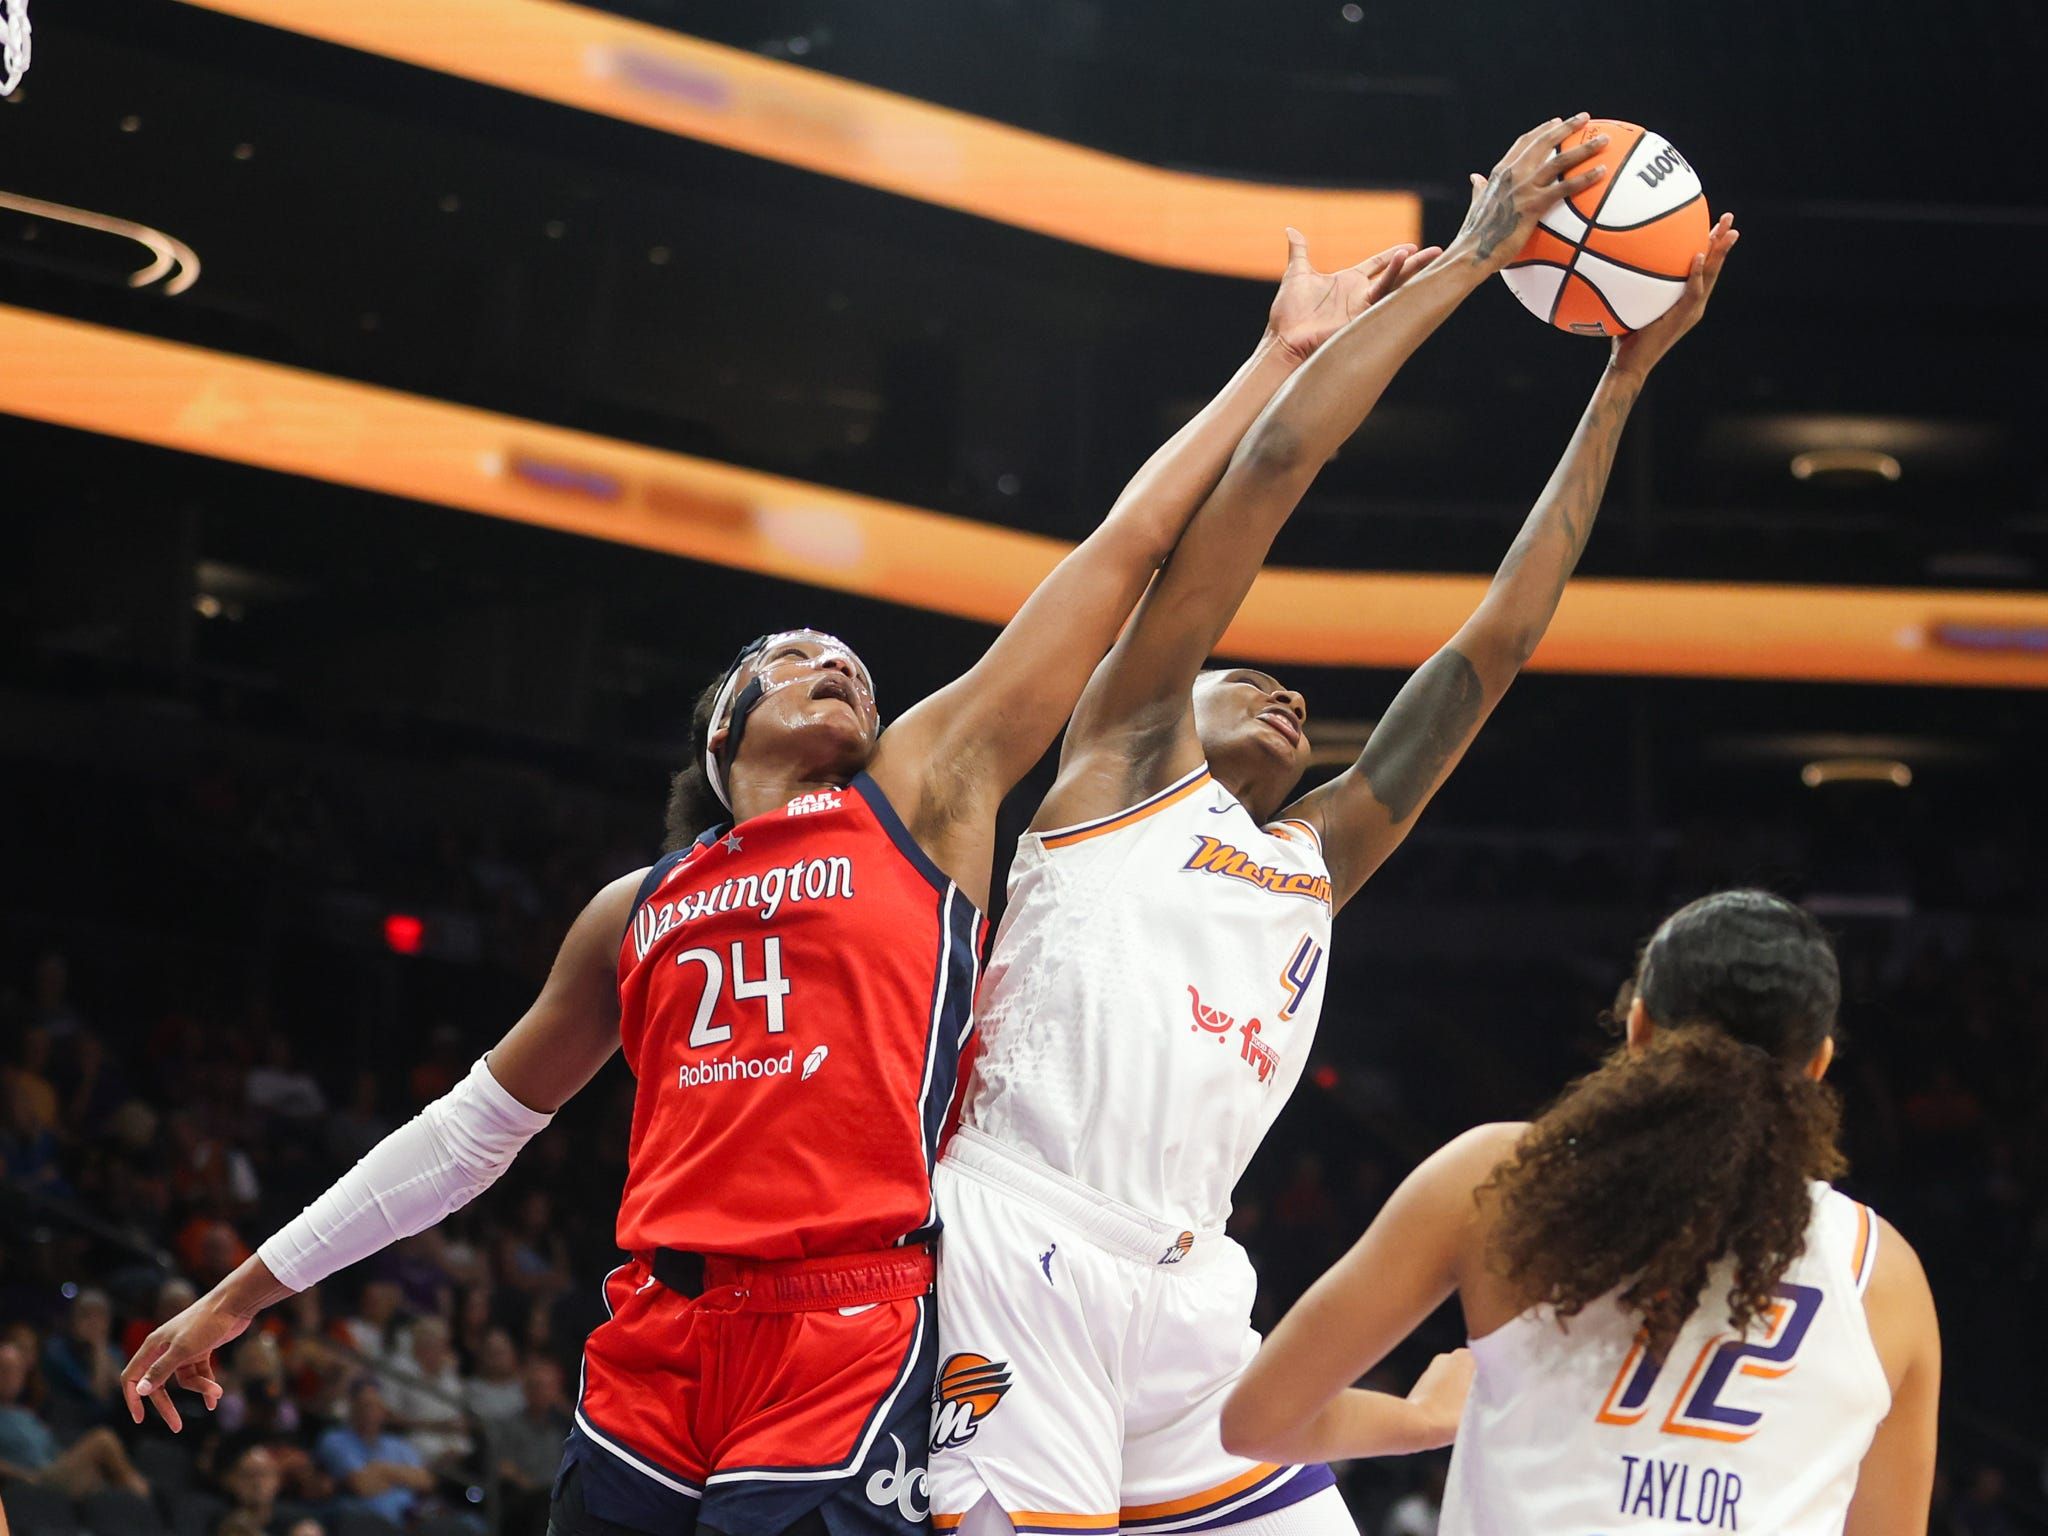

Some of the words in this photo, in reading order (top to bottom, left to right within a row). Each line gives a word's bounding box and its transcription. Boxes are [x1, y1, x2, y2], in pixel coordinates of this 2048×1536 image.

[787, 792, 832, 808] CAR
[787, 798, 842, 817] max
[633, 855, 854, 963] Washington
[676, 936, 791, 1049] 24
[1278, 931, 1323, 1022] 4
[679, 1050, 793, 1089] Robinhood
[1620, 1455, 1742, 1531] TAYLOR
